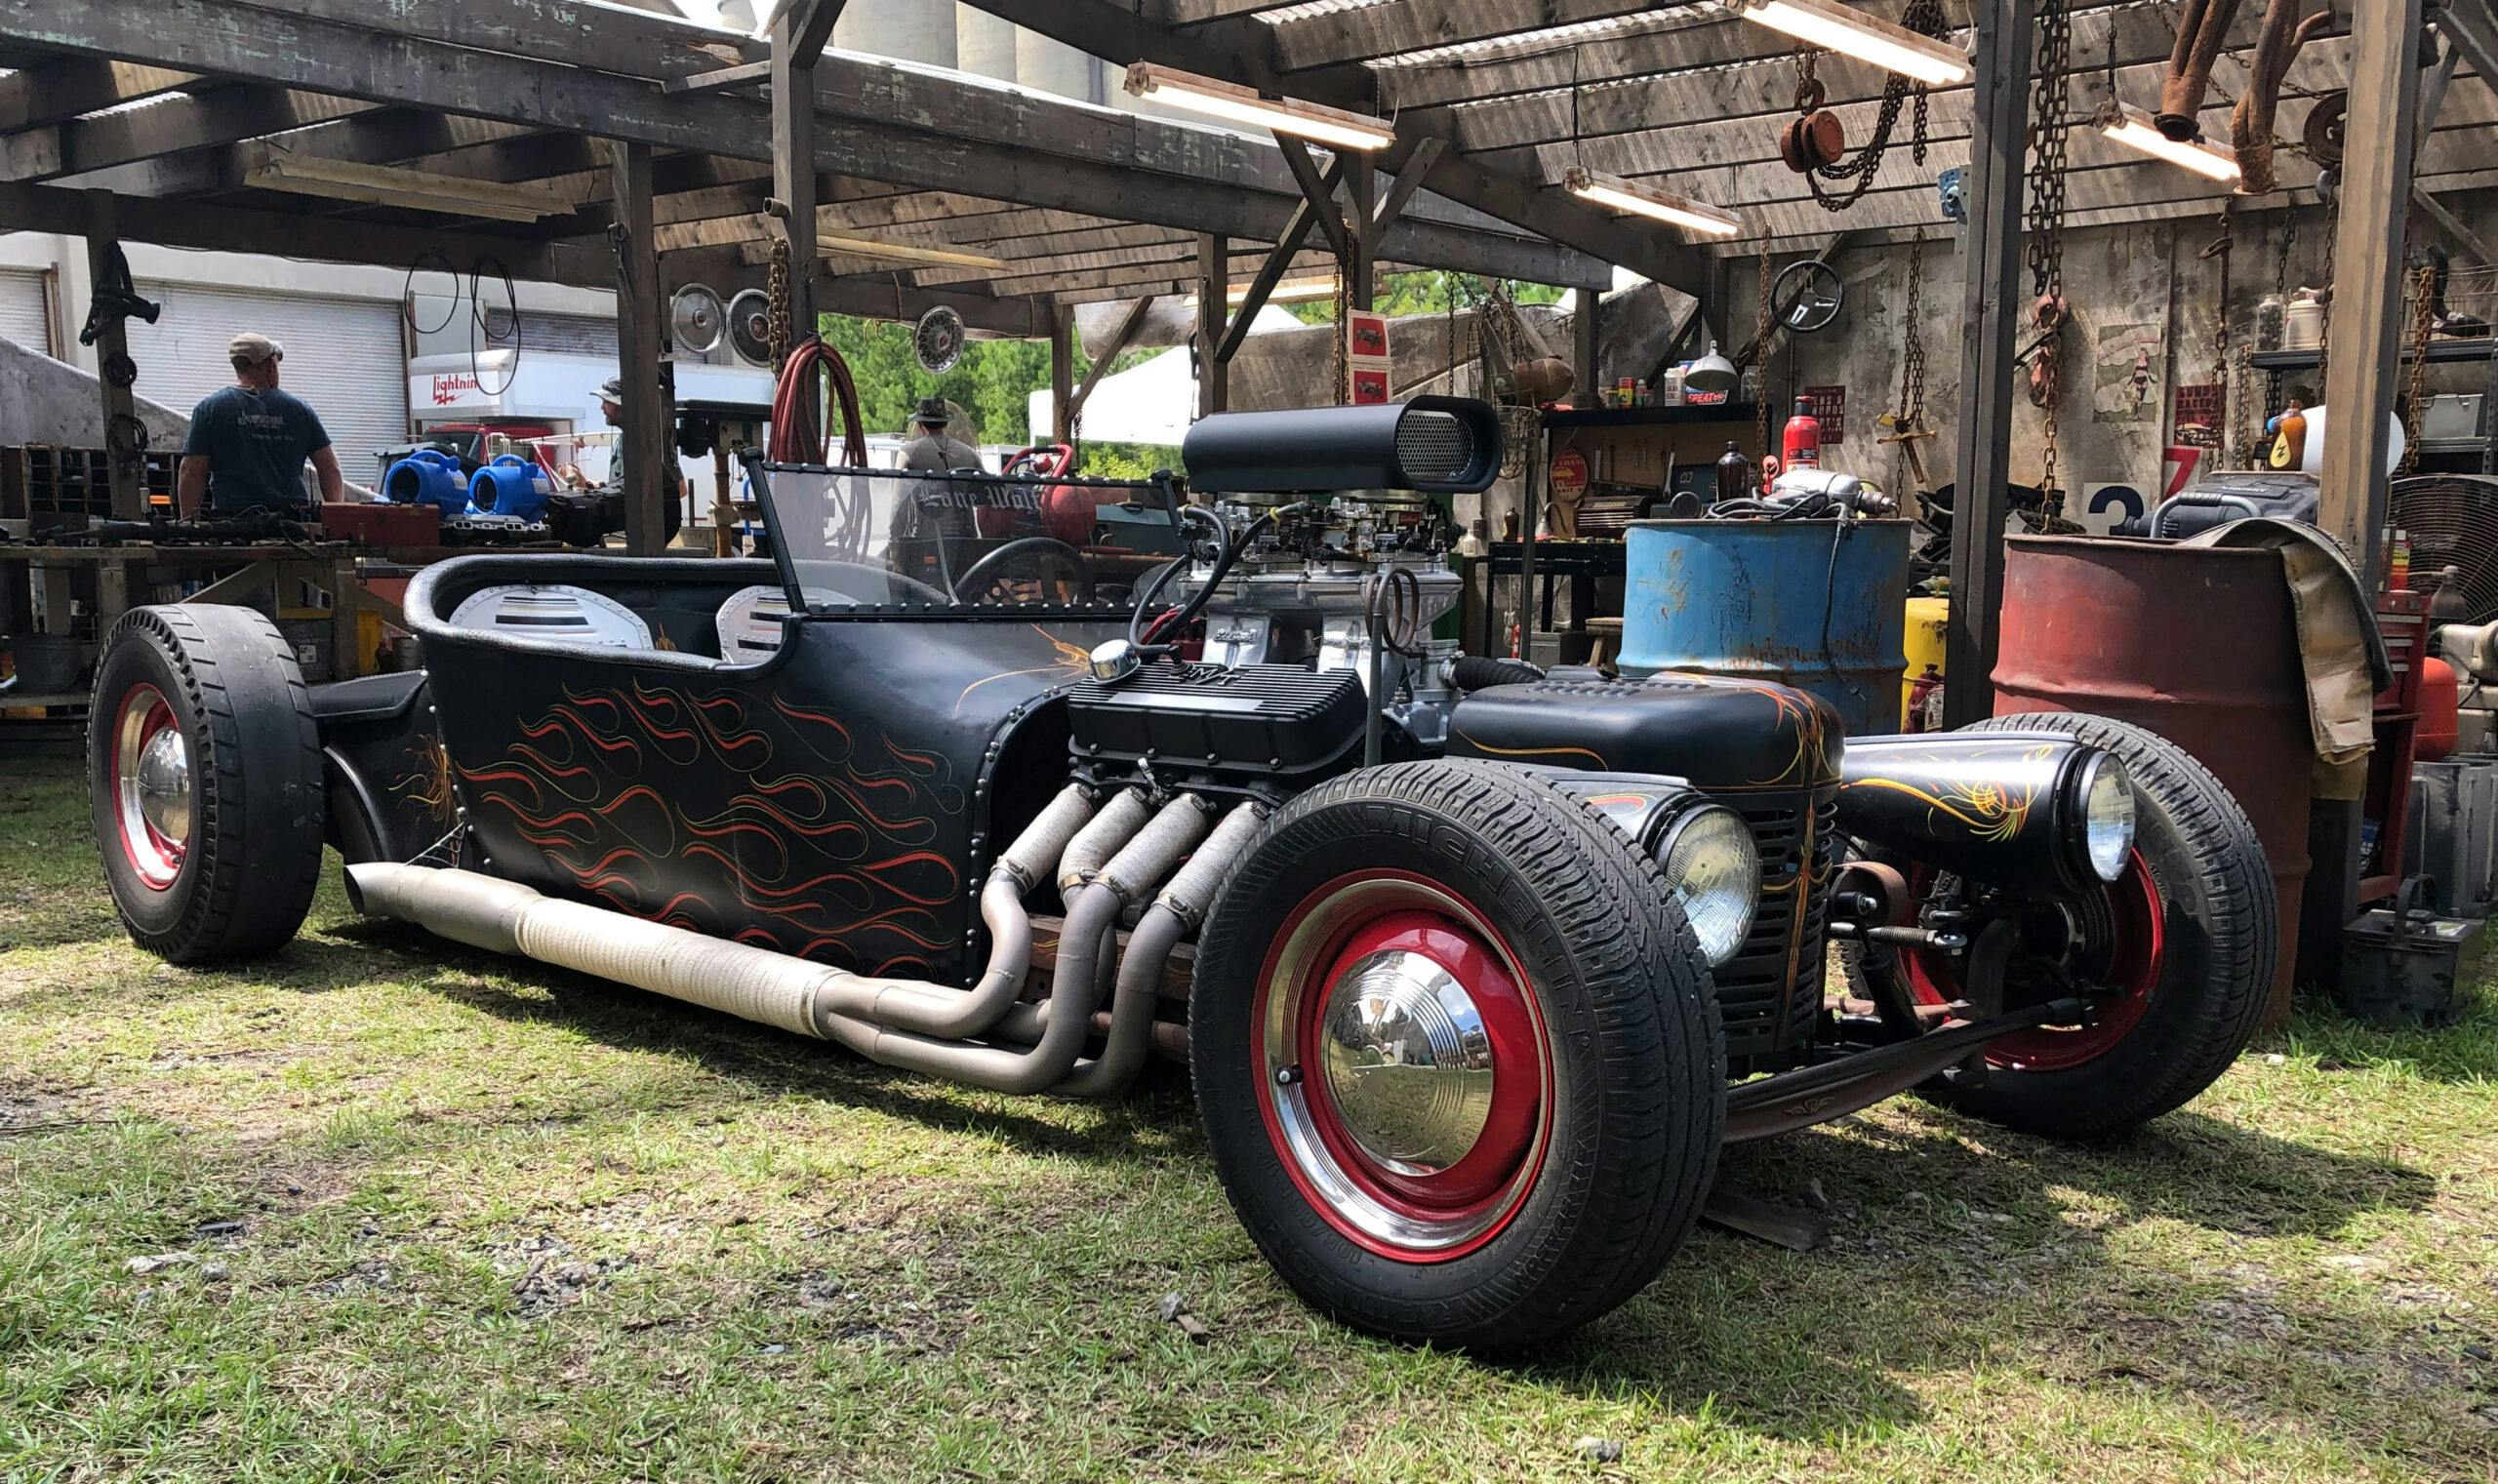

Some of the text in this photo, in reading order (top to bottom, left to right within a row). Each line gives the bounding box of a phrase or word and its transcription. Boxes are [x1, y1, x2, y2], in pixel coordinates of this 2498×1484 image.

[918, 486, 1042, 510] Lone Wolf
[2163, 447, 2201, 502] 7
[1367, 807, 1587, 1036] MICHELIN
